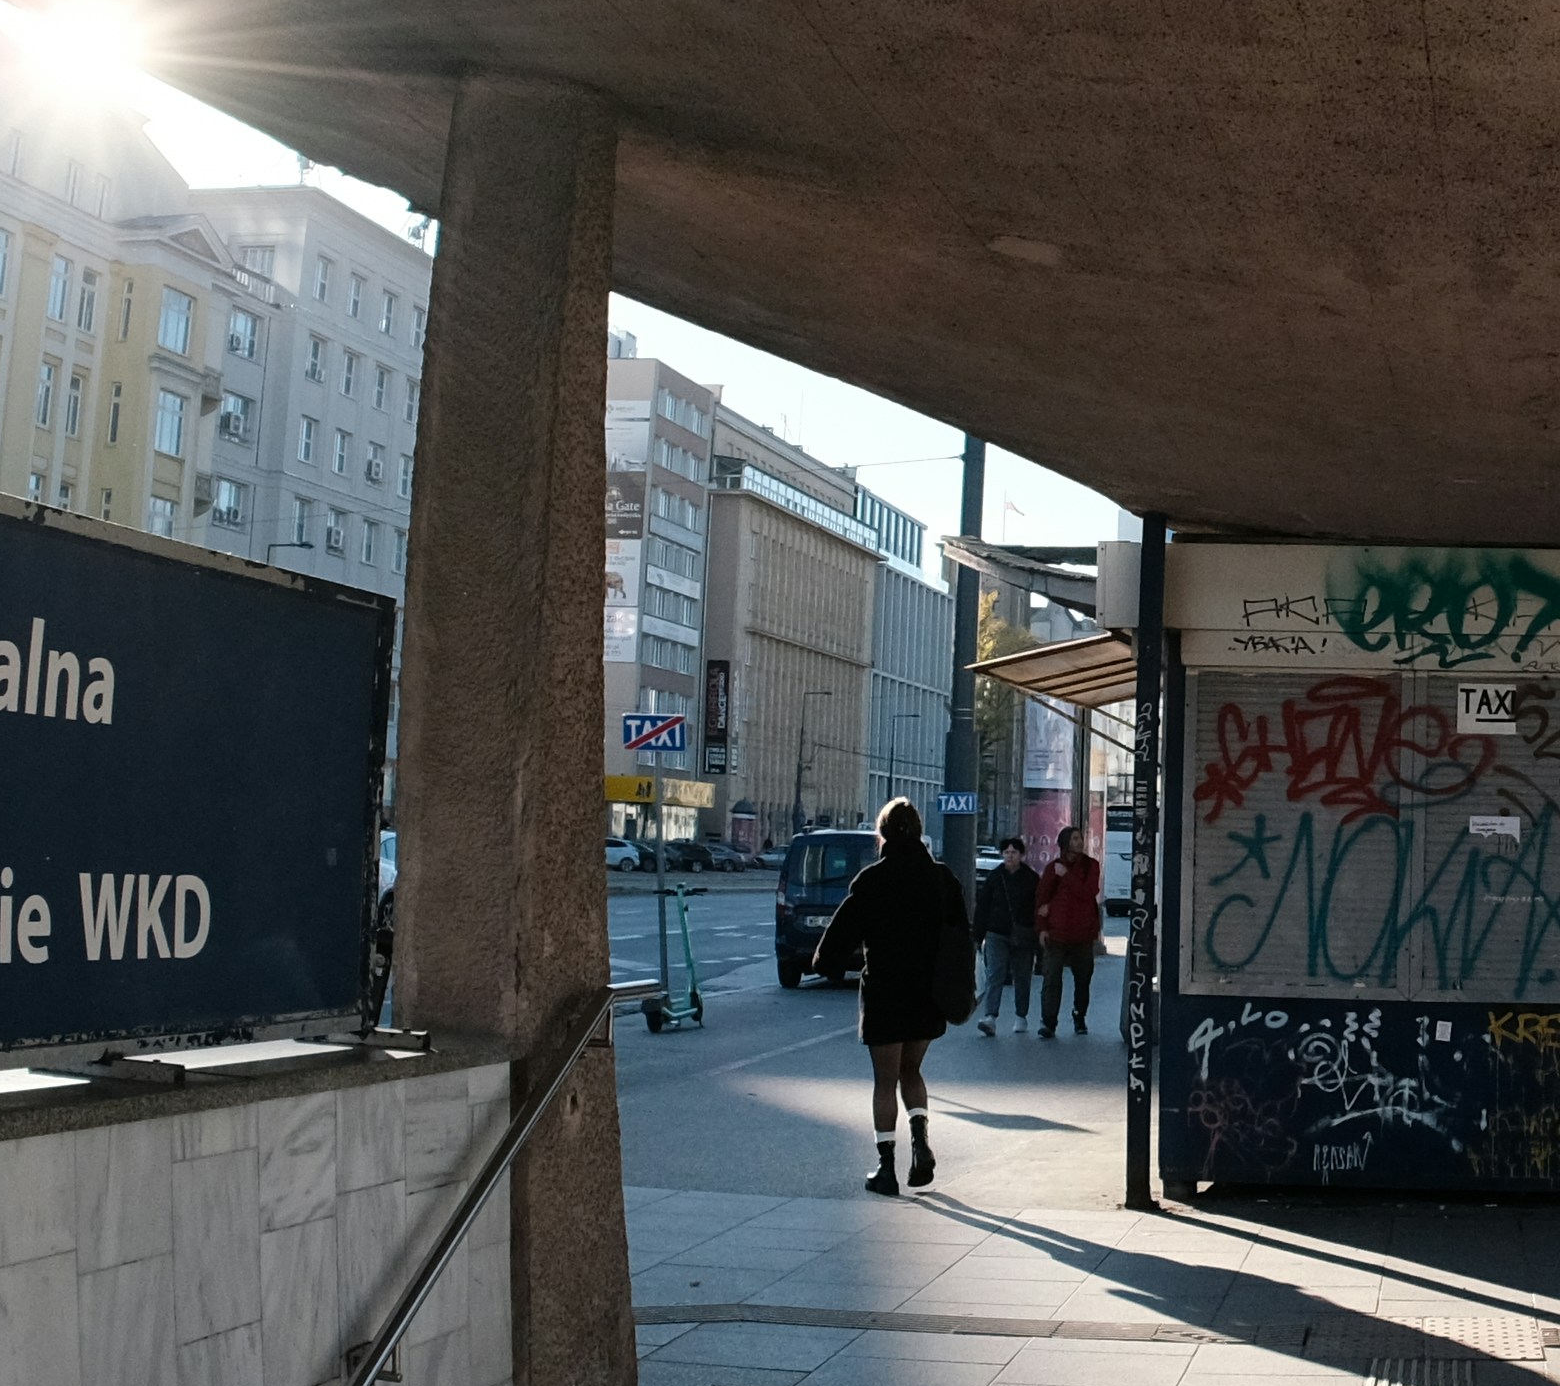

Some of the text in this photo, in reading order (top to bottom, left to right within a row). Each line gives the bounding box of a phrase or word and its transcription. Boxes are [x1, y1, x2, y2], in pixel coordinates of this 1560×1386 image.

[1459, 687, 1517, 715] TAXI
[626, 718, 682, 748] TAXI
[939, 794, 974, 812] TAXI
[79, 872, 211, 961] WKD
